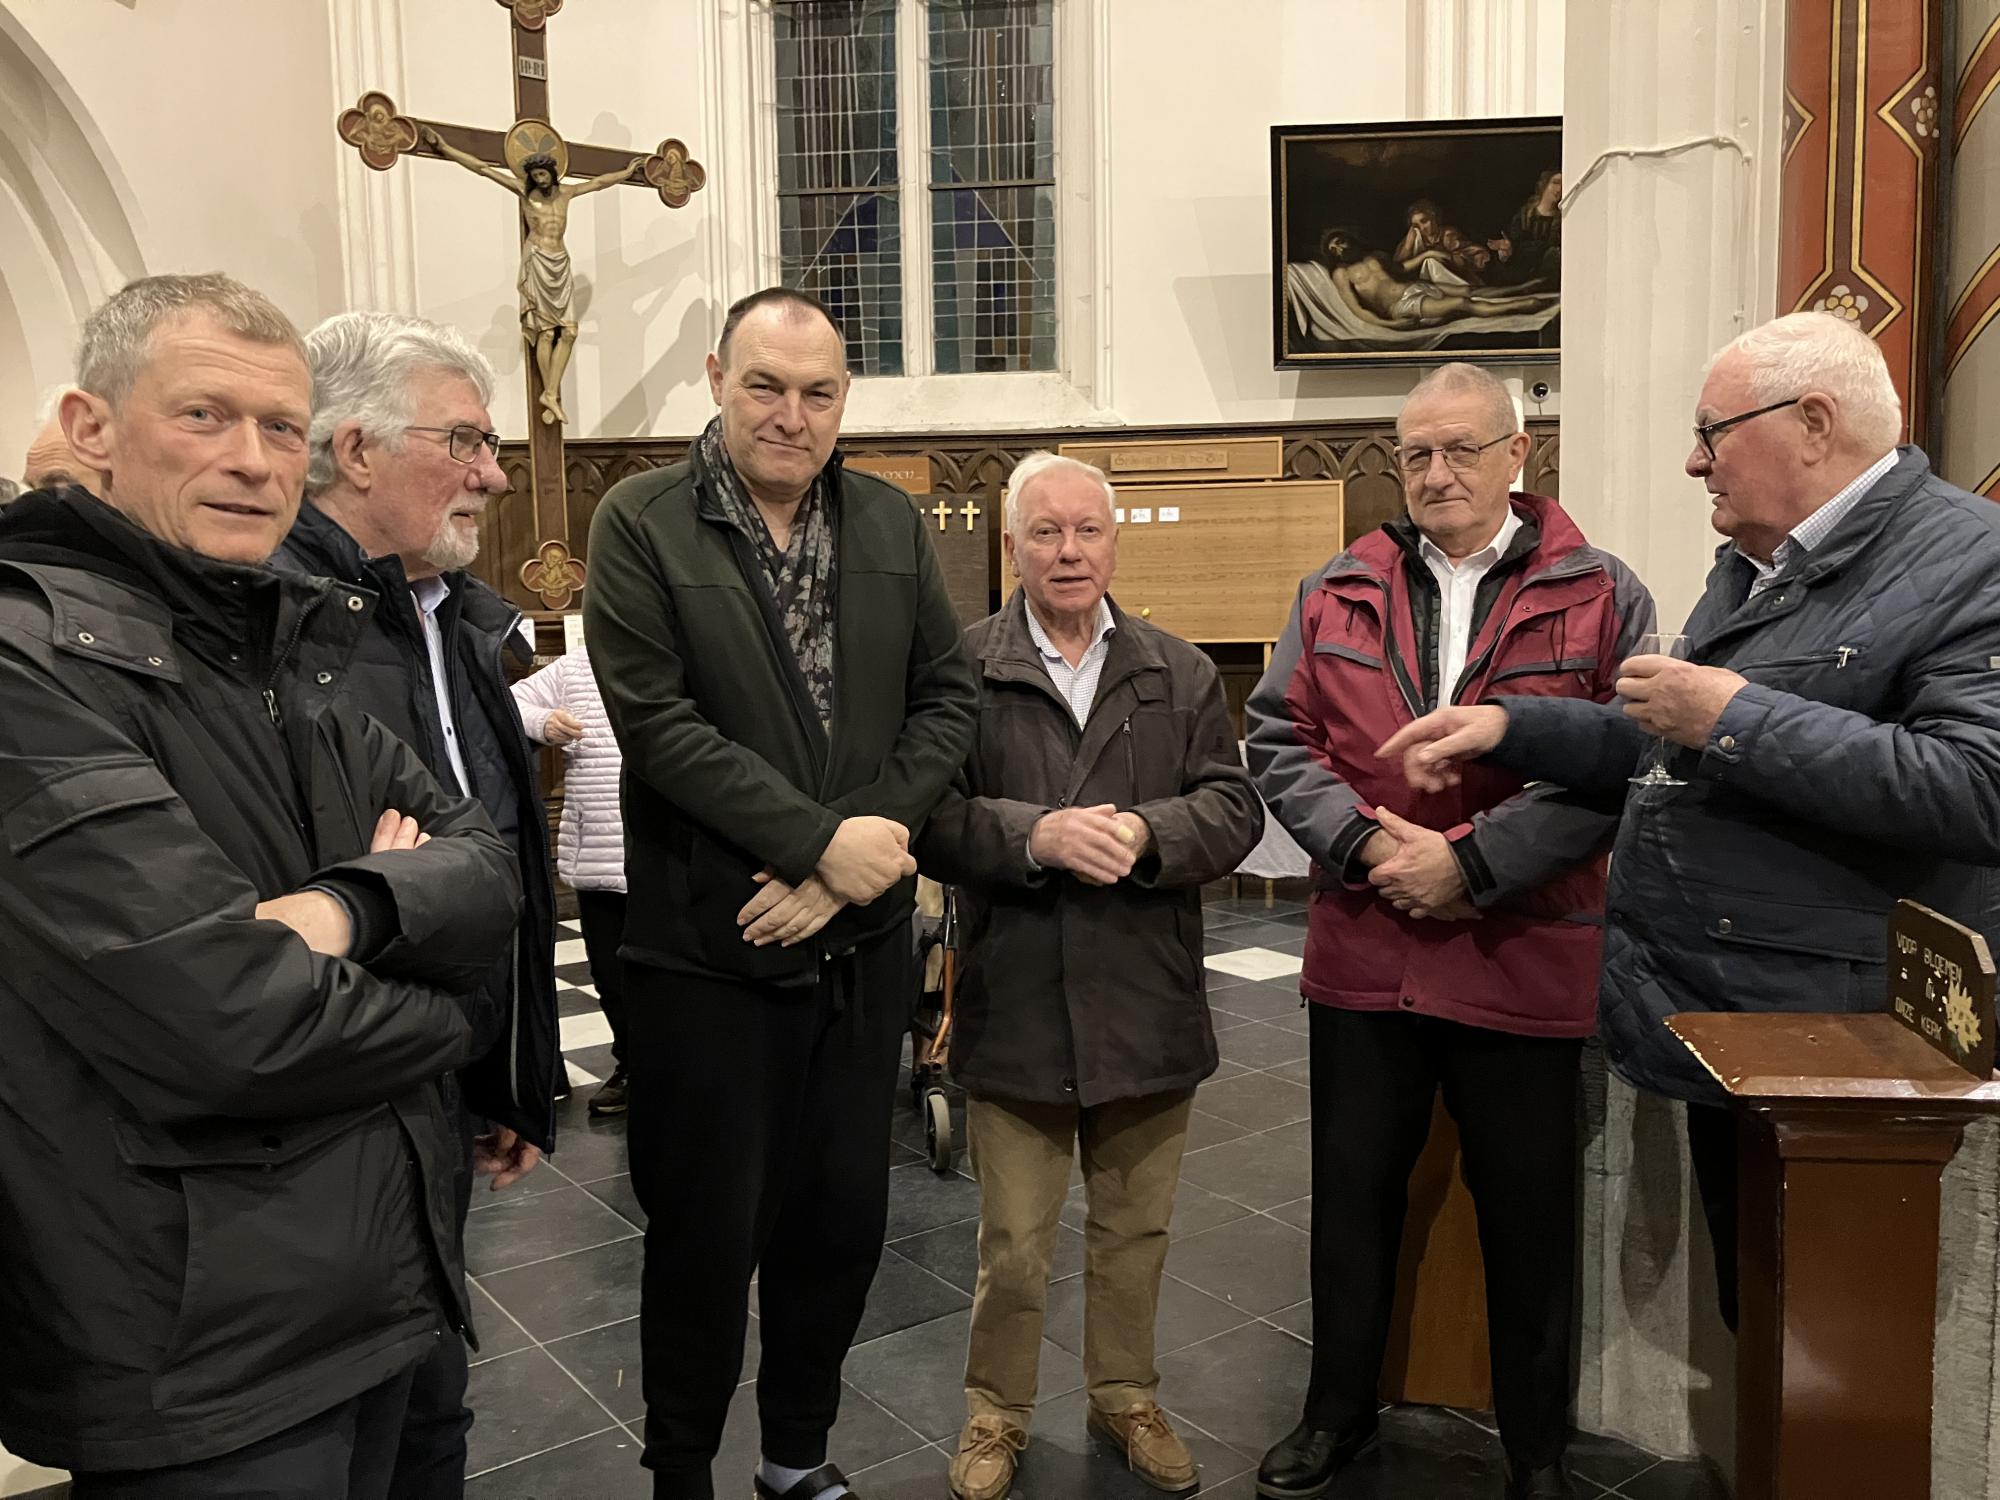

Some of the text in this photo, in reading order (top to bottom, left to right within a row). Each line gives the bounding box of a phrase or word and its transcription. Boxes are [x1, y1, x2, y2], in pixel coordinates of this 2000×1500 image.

[1896, 931, 1962, 984] VOOR BLOEMEN
[1895, 996, 1942, 1041] ONZE KERK
